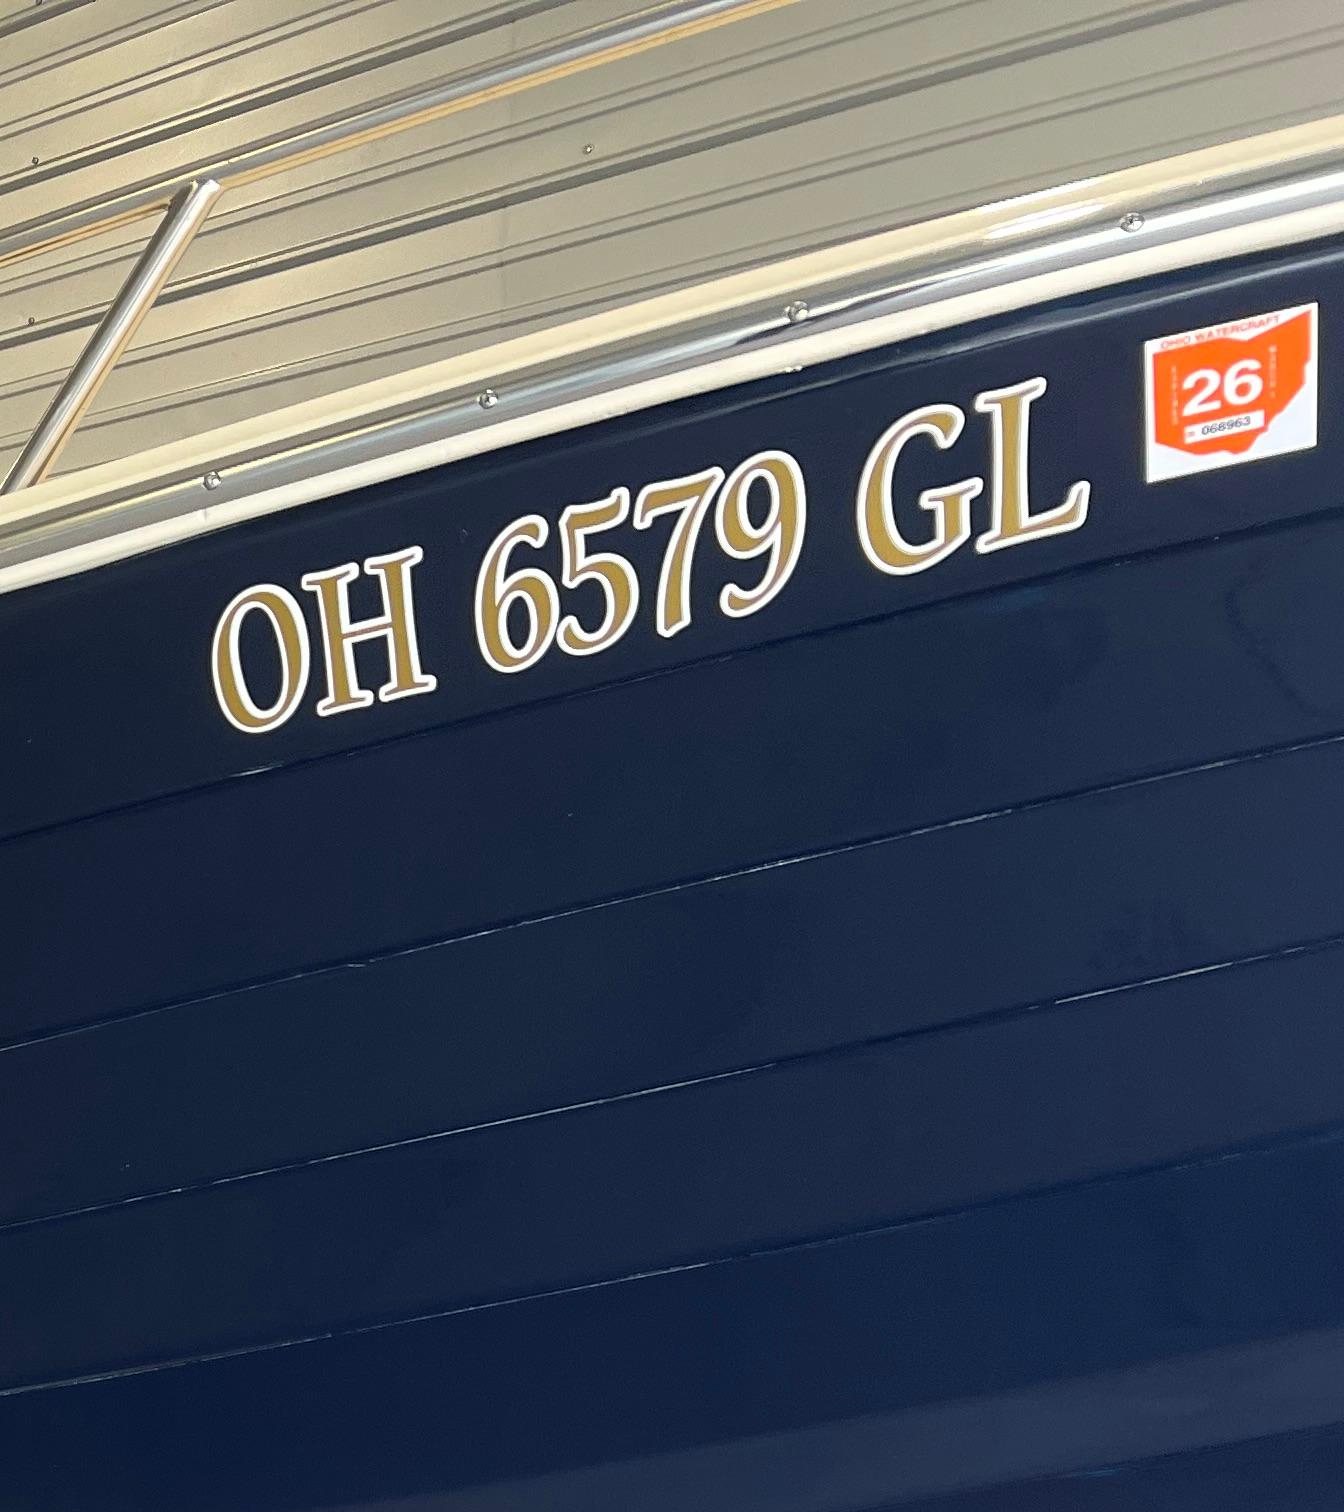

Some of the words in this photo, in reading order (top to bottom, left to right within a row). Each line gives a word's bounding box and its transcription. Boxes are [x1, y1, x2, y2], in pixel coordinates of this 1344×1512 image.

[1161, 335, 1191, 350] OHIO
[1195, 315, 1280, 340] WATERCRAFT
[1182, 359, 1263, 417] 26
[1201, 415, 1251, 435] 068963
[210, 545, 436, 734] OH
[474, 449, 807, 673] 6579
[856, 376, 1091, 576] GL
